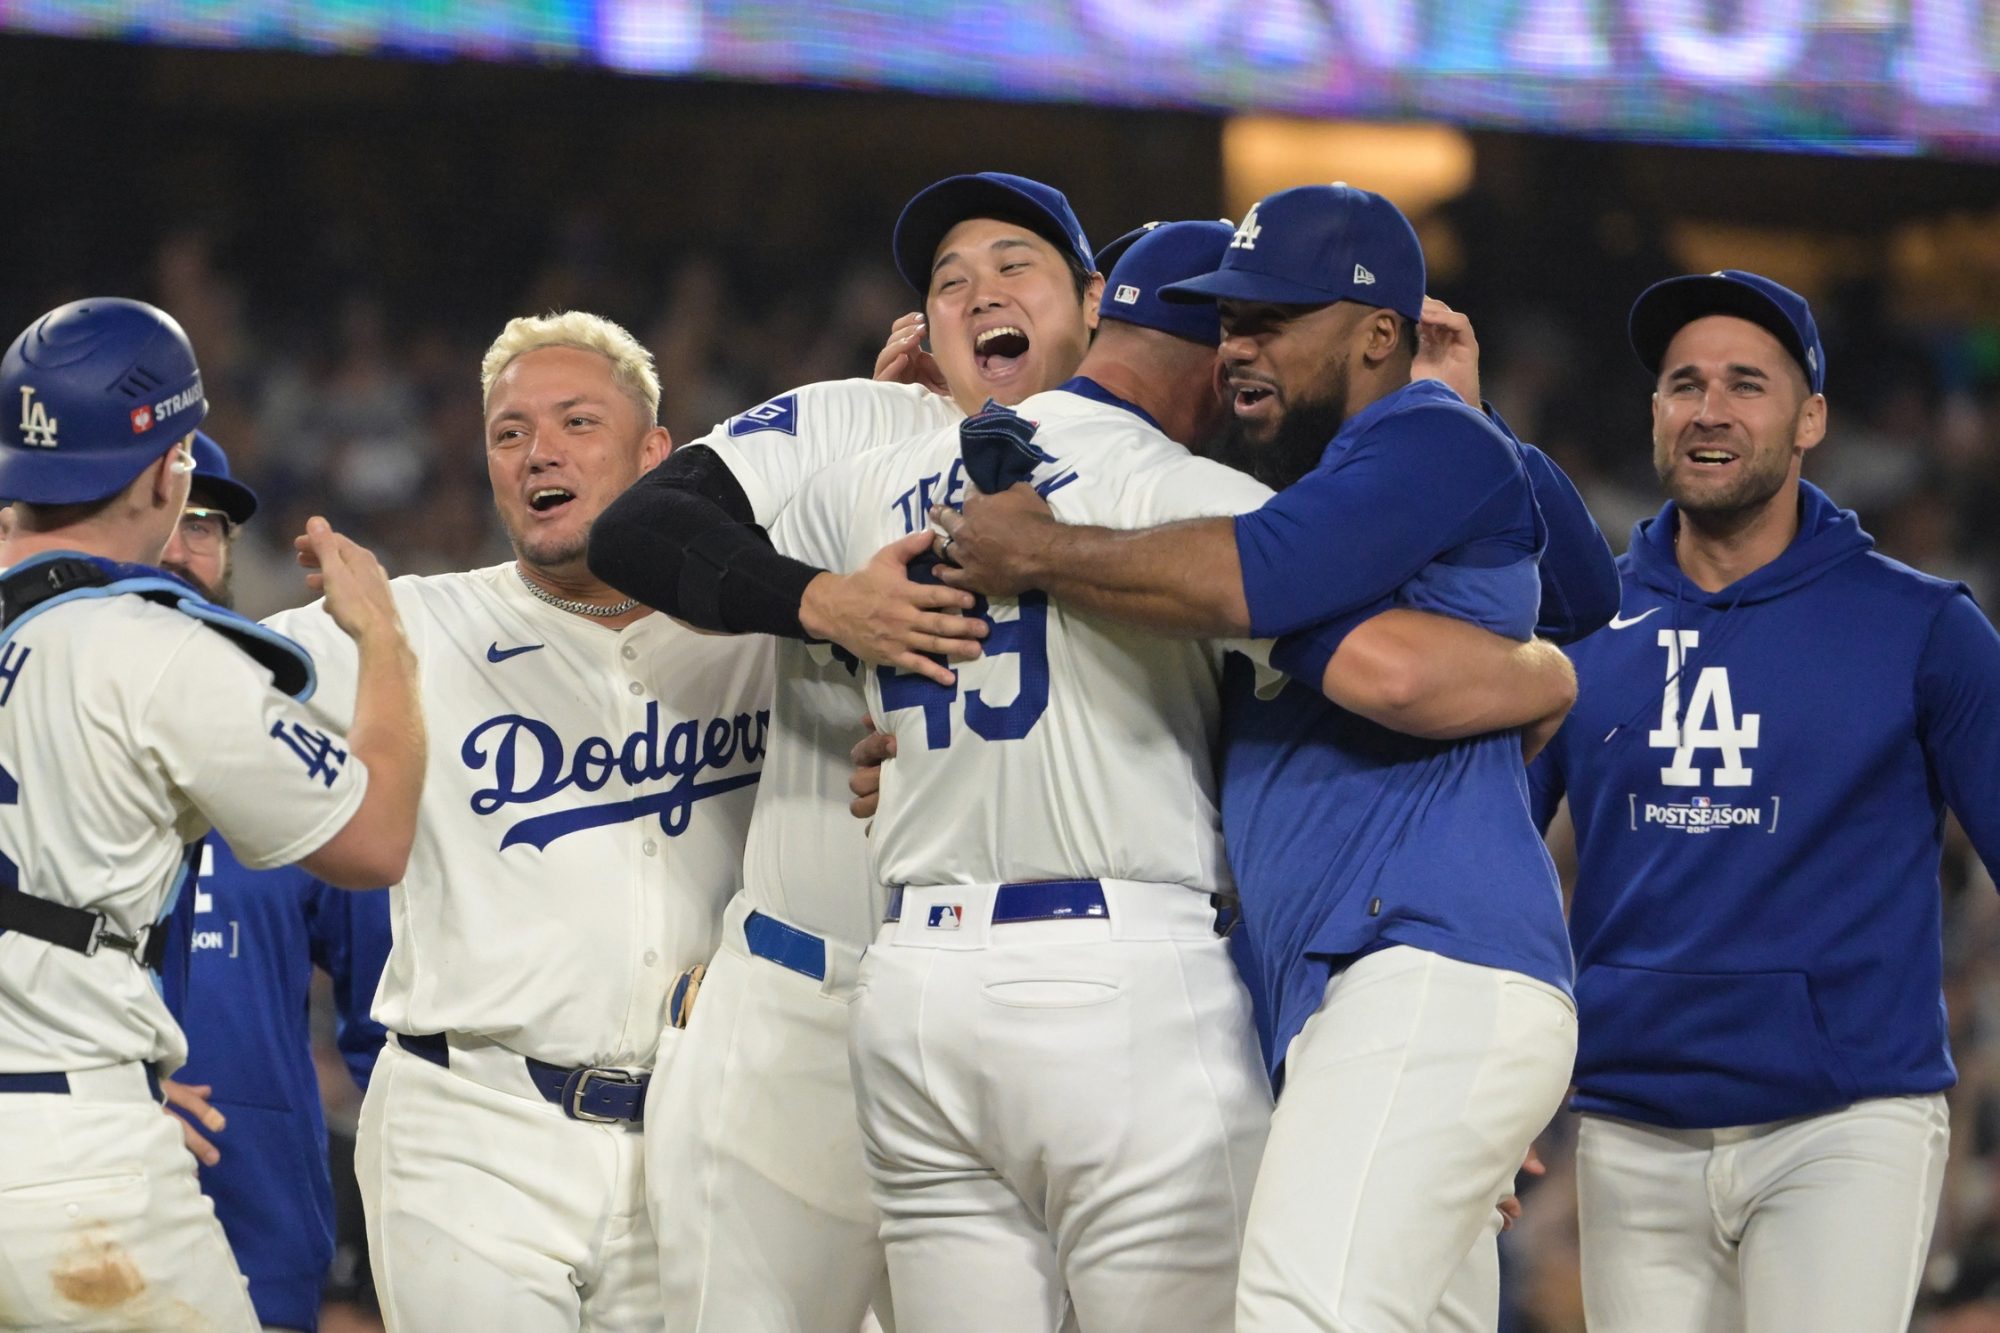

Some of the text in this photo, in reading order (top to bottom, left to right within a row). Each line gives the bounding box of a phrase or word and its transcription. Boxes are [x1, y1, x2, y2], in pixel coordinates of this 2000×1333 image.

[1230, 202, 1262, 250] LA
[19, 386, 57, 447] LA
[154, 383, 203, 421] STRAUS
[1649, 629, 1760, 787] LA
[270, 719, 347, 789] LA
[1645, 804, 1760, 825] POSTSEASON
